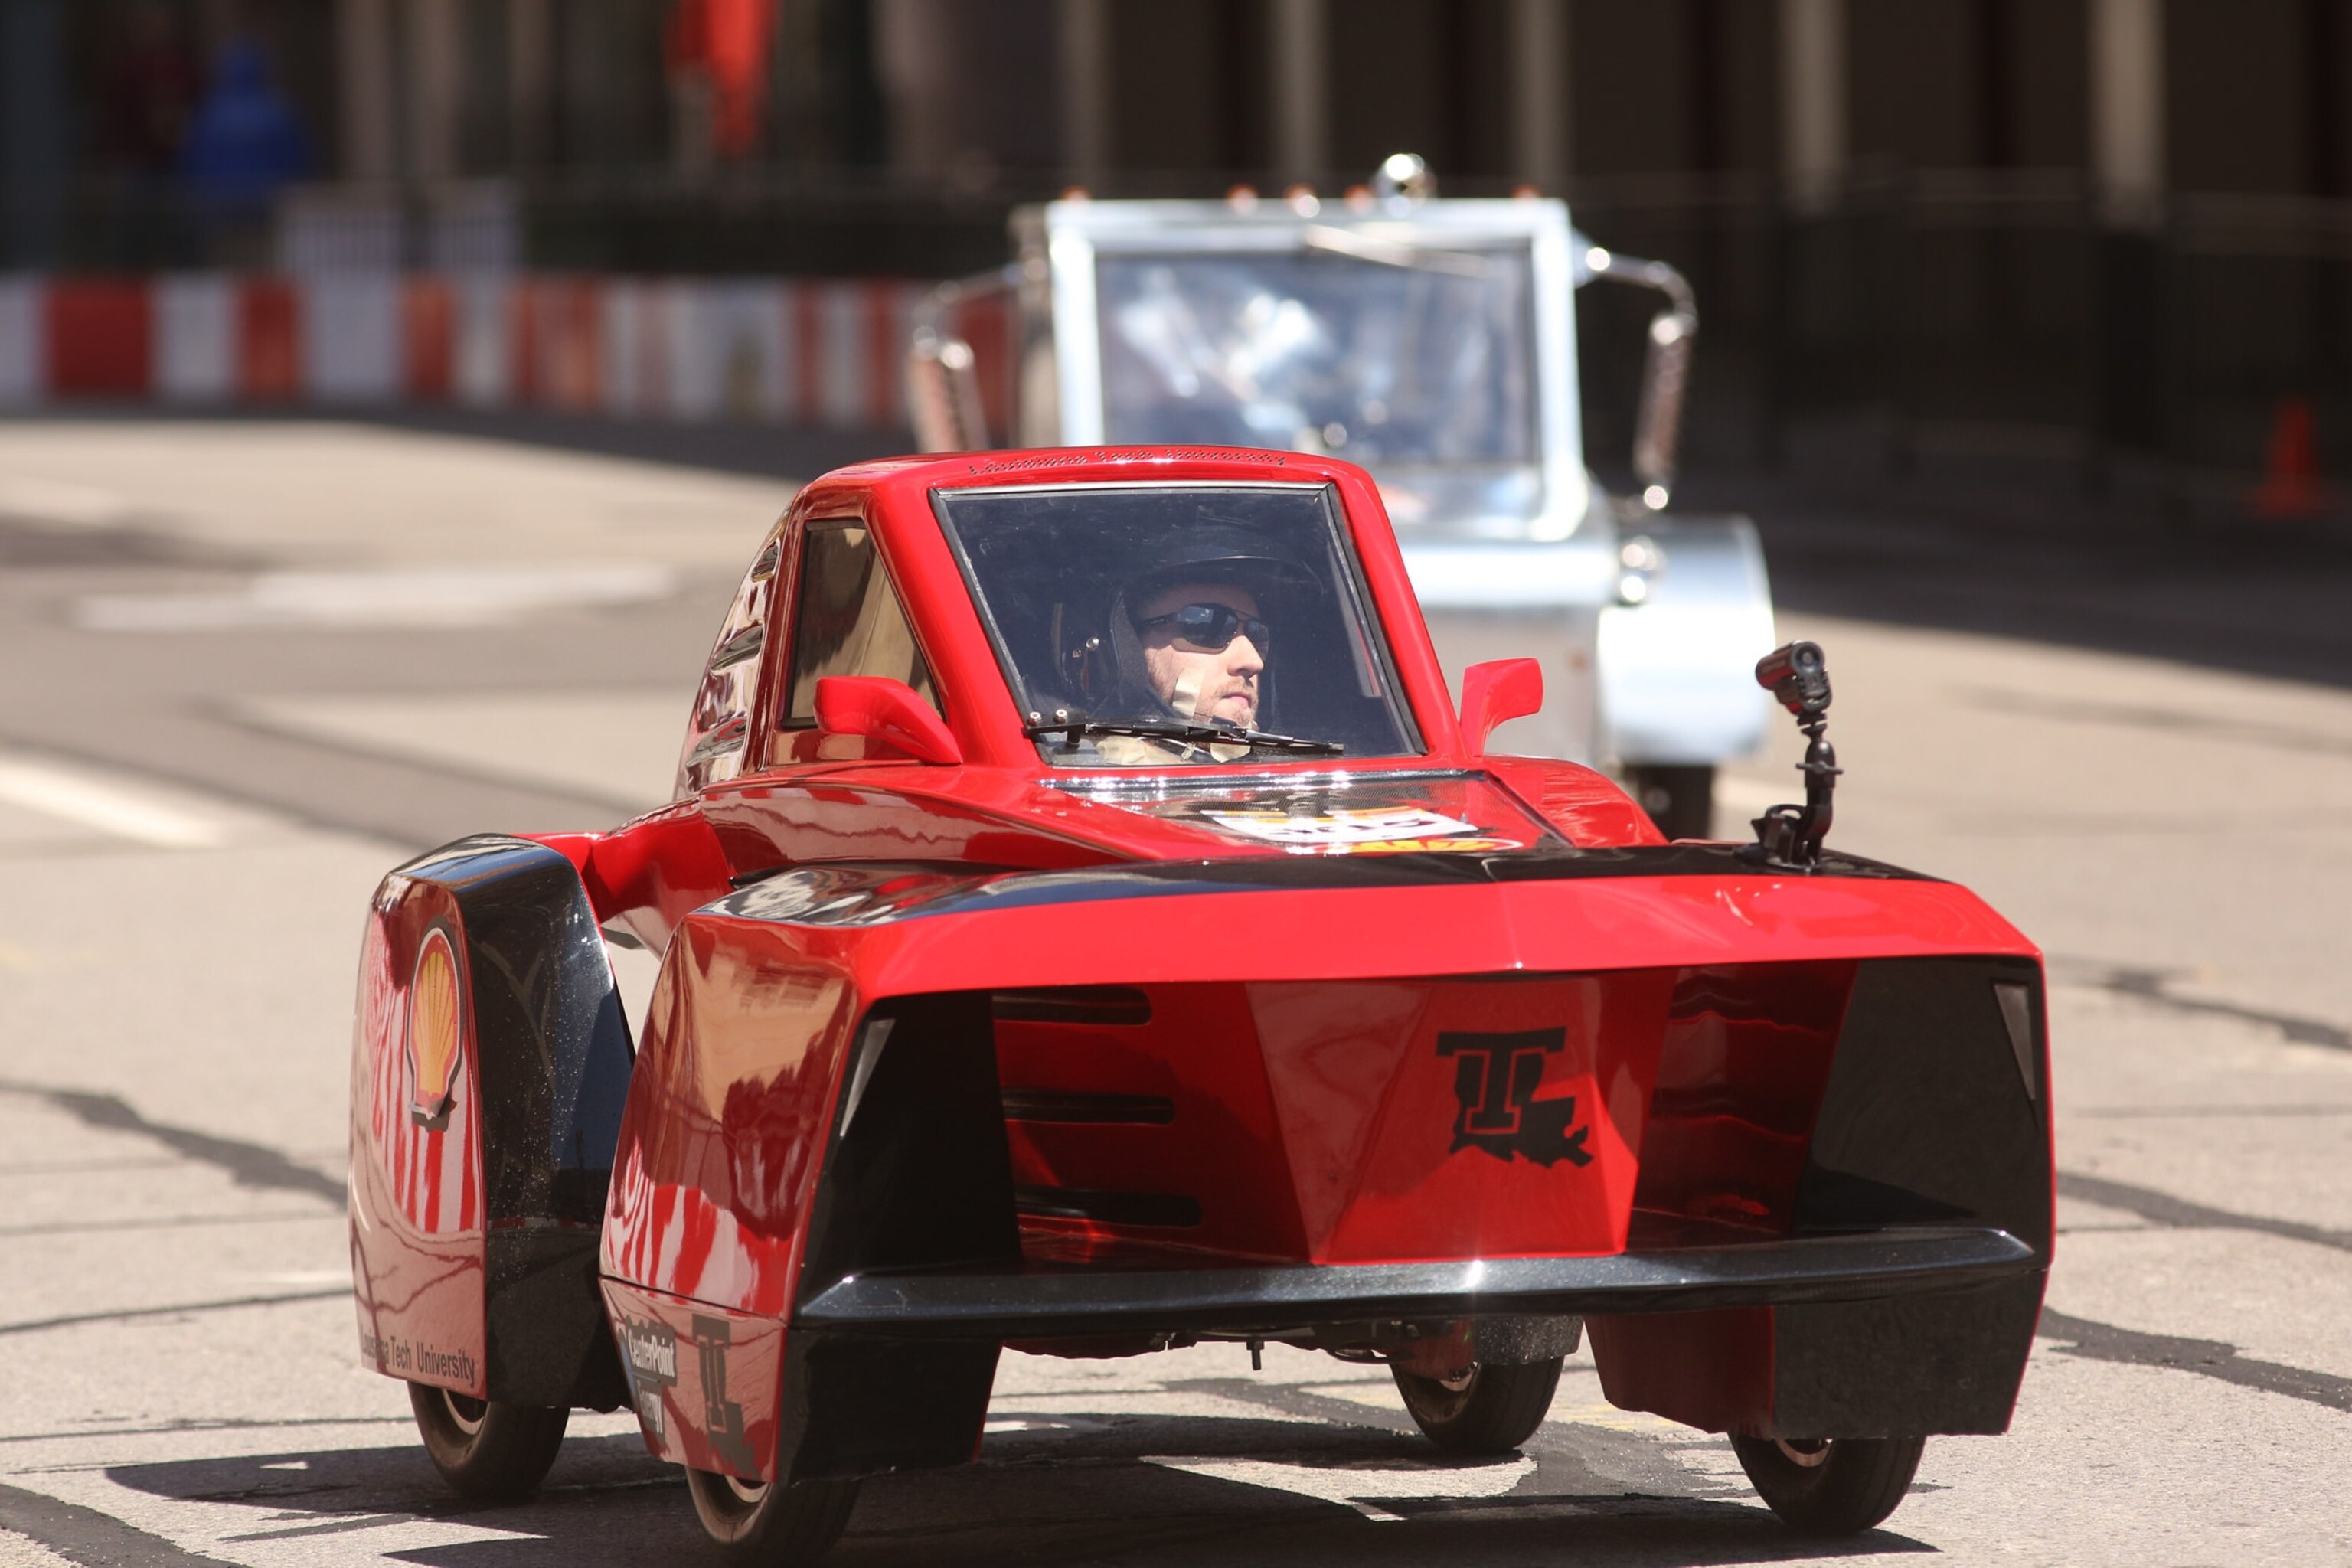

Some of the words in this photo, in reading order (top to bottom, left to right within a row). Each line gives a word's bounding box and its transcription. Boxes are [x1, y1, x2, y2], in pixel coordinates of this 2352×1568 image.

[969, 455, 1088, 475] Louisiana
[1094, 450, 1153, 463] Tech
[1165, 449, 1285, 466] University
[390, 1335, 412, 1370] Tech
[416, 1341, 475, 1389] University
[627, 1328, 676, 1378] CenterPoint
